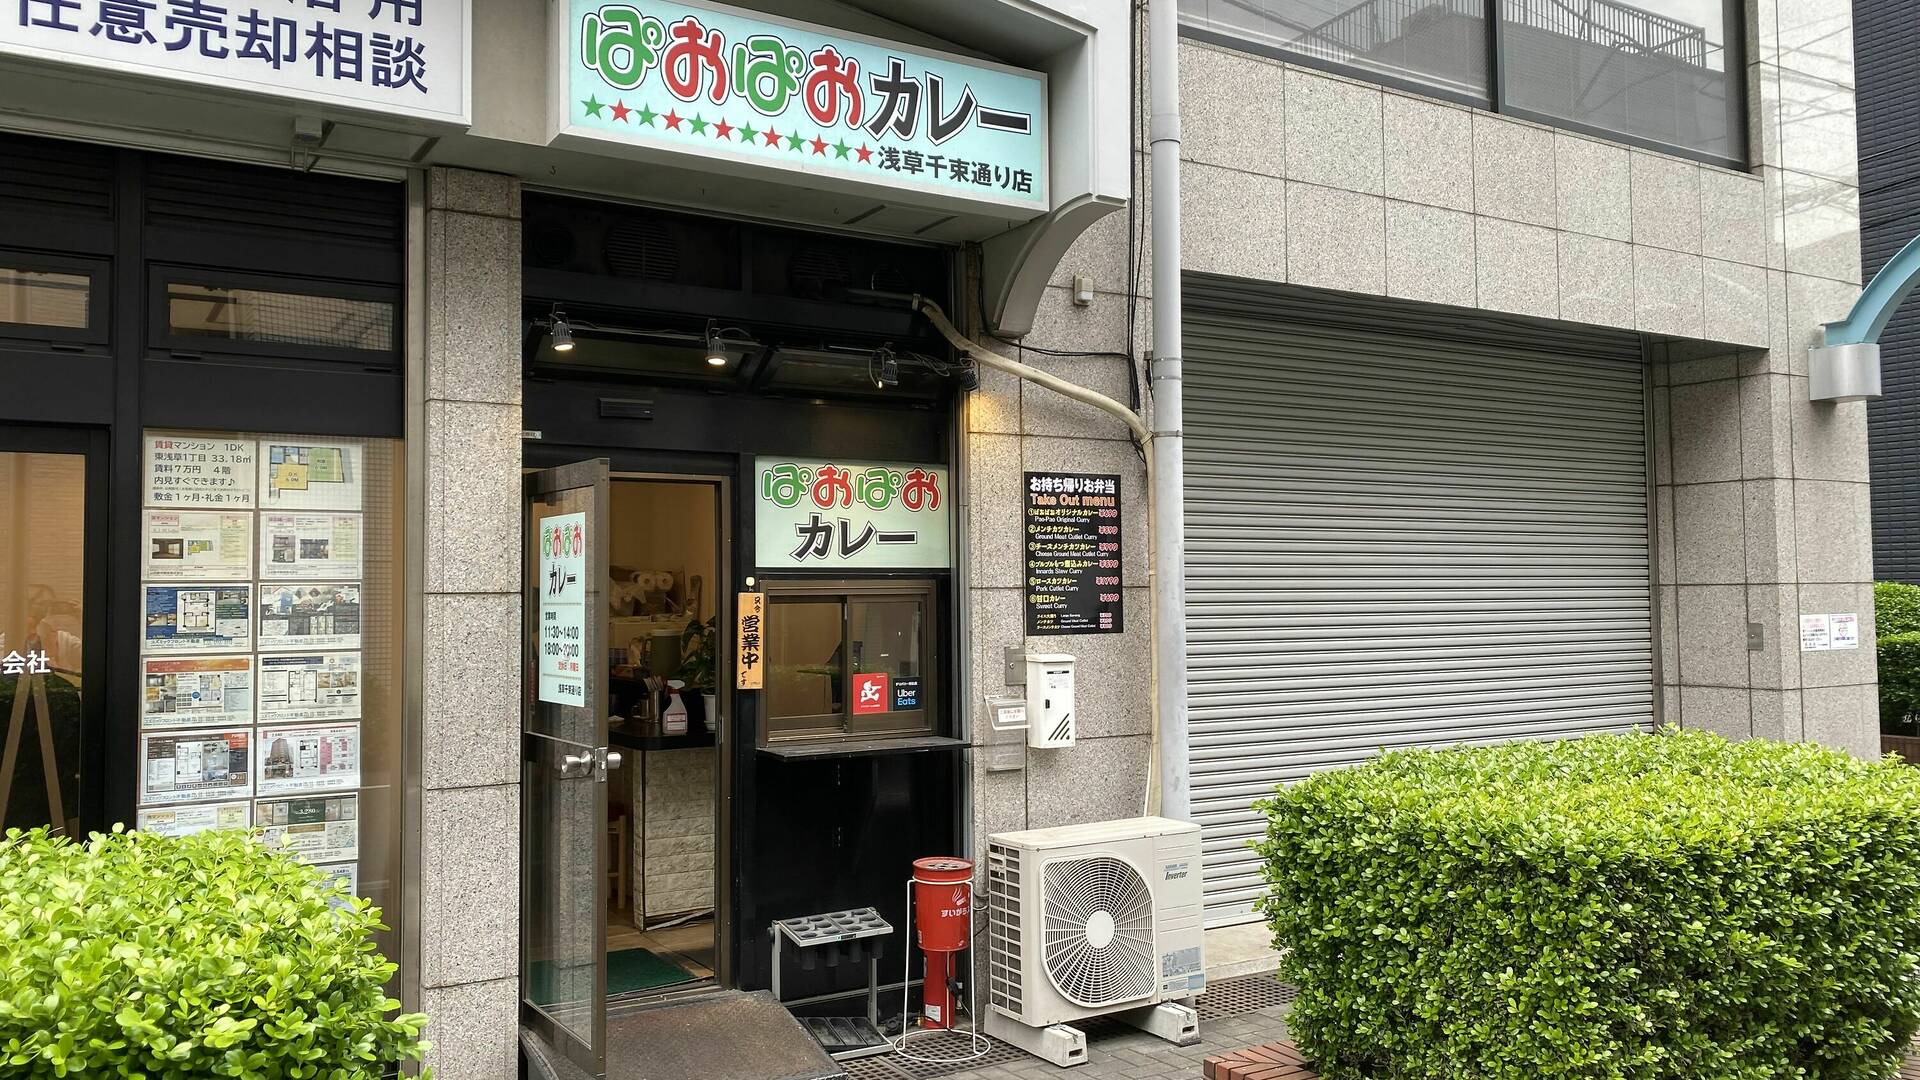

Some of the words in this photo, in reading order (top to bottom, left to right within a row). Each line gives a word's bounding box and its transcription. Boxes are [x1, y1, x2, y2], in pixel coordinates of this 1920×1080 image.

[878, 145, 1032, 193] 浅草千束通り店
[155, 441, 215, 451] 賃貸マンション
[224, 444, 244, 452] 1DK
[154, 452, 206, 462] 東浅草1丁目
[762, 463, 942, 512] ぱおぱお
[1030, 477, 1115, 494] お持ち帰りお弁当
[1030, 493, 1057, 506] Take
[1060, 493, 1079, 506] Out
[1082, 495, 1115, 507] menu
[789, 512, 918, 562] カレー
[549, 562, 577, 599] カレー
[741, 614, 760, 669] 営業中
[897, 689, 916, 697] Uber
[897, 698, 916, 706] Eats
[1165, 871, 1188, 880] Inverter
